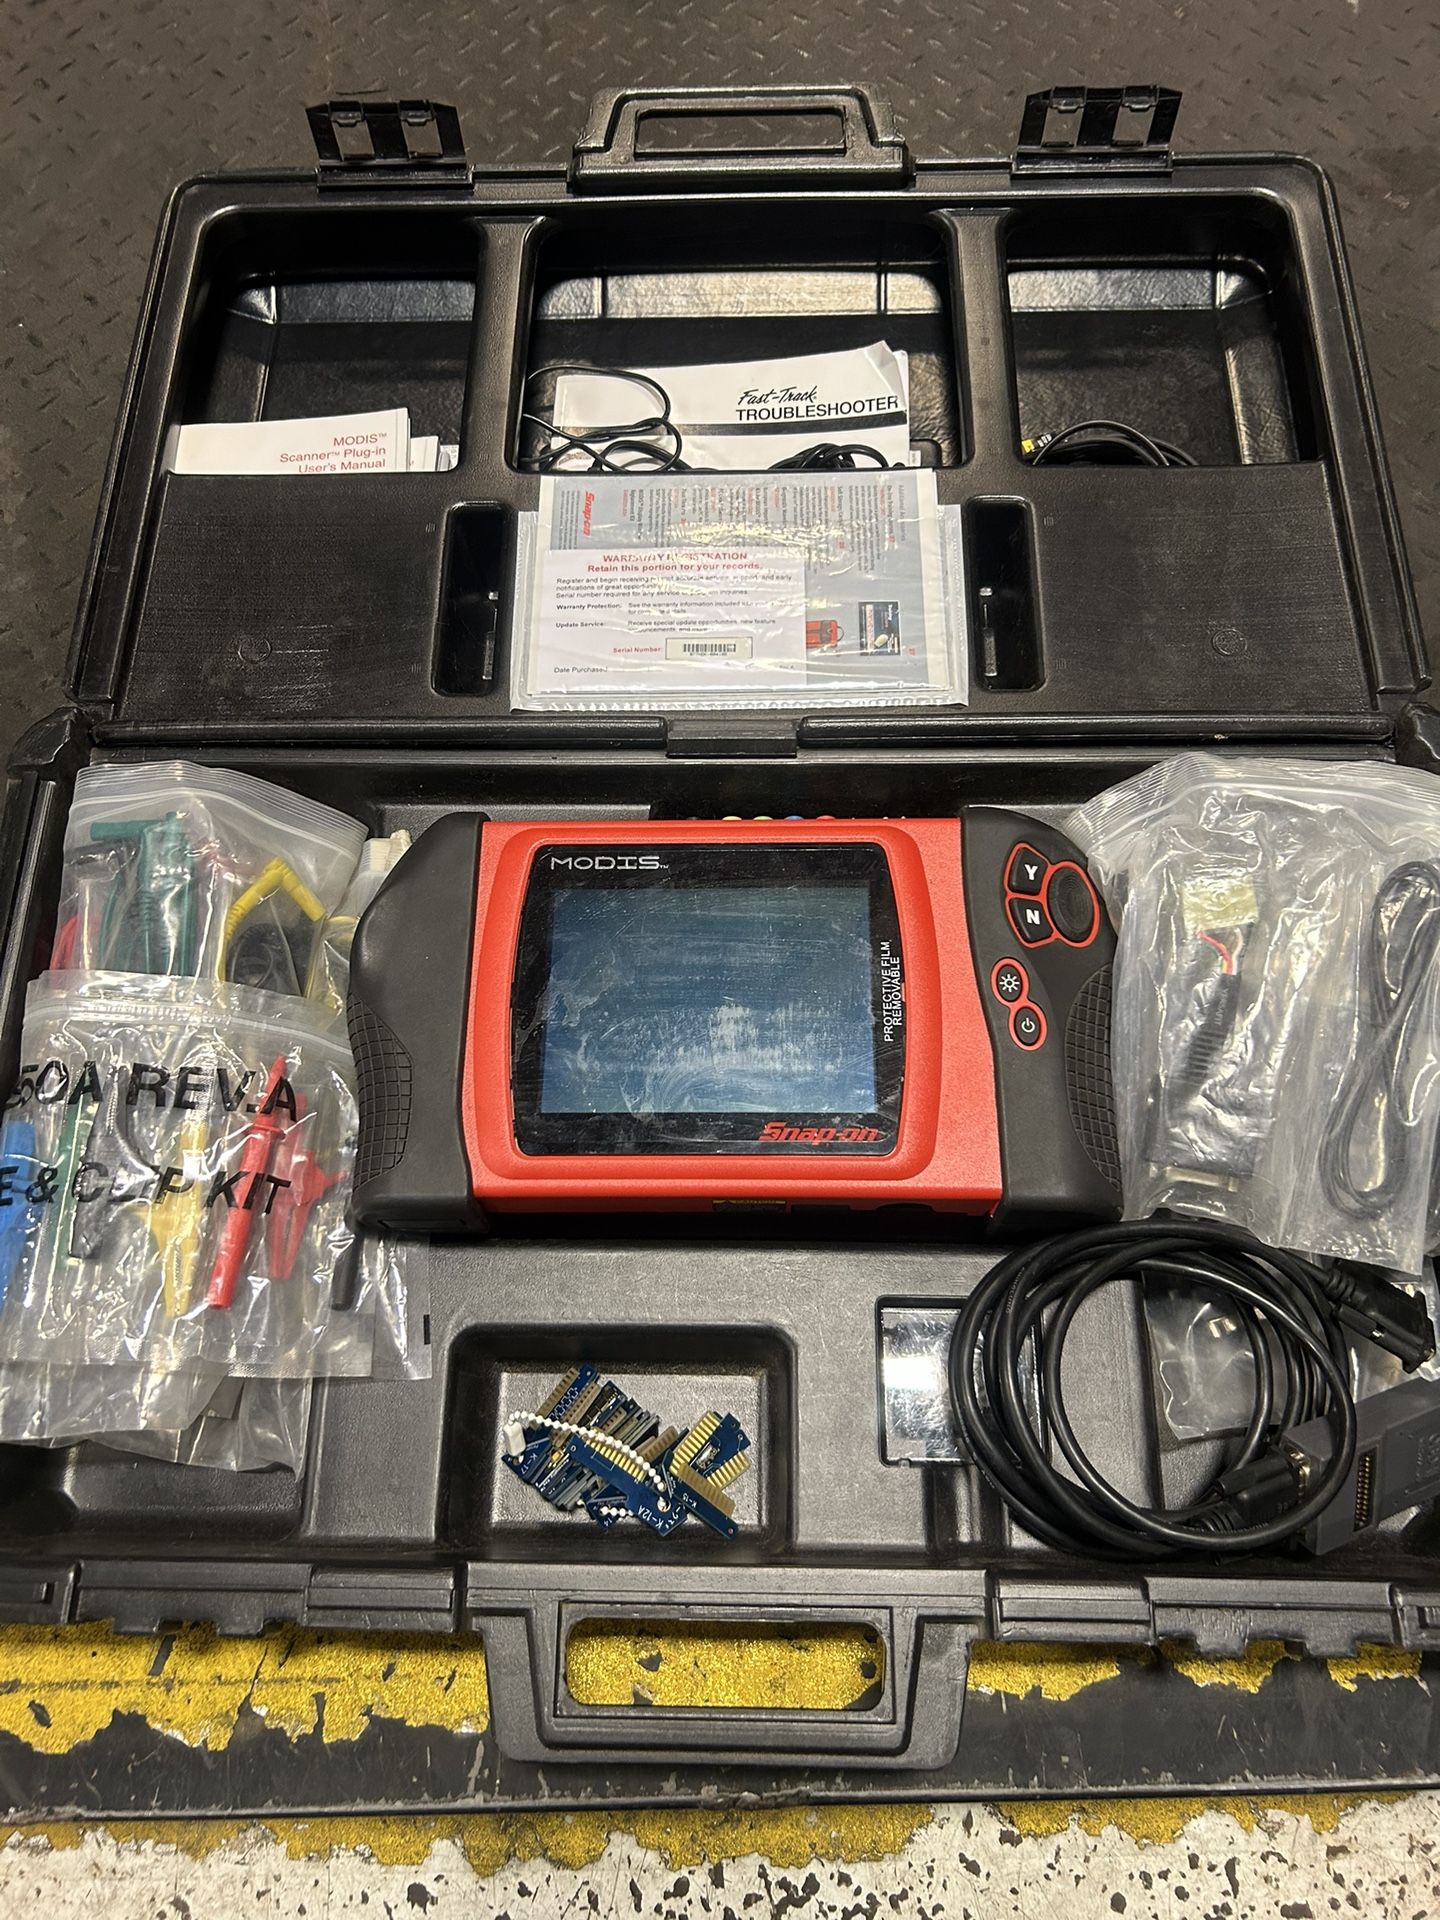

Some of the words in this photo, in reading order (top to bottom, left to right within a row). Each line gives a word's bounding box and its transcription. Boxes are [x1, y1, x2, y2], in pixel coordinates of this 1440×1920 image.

[736, 395, 899, 422] TROUBLESHOOTER
[343, 447, 386, 459] Plug-in
[298, 462, 337, 474] User's
[340, 459, 386, 471] Manual
[582, 491, 595, 537] Snap-on
[588, 564, 618, 572] Retain
[621, 563, 639, 571] this
[642, 563, 677, 573] portion
[680, 562, 694, 571] for
[696, 562, 720, 572] your
[556, 577, 585, 585] Register
[600, 576, 619, 585] begin
[605, 584, 622, 592] great
[577, 591, 601, 599] number
[603, 591, 630, 599] required
[557, 603, 586, 611] Warranty
[587, 602, 622, 610] Protection:
[680, 601, 713, 609] information
[653, 620, 675, 628] special
[554, 666, 570, 674] Date
[1024, 863, 1039, 881] Y
[1026, 908, 1040, 925] N
[880, 941, 891, 967] FILM
[890, 956, 902, 1026] REMOVABLE
[881, 969, 894, 1042] PROTECTIVE
[758, 1120, 880, 1147] Snap-on
[25, 1166, 58, 1204] &
[204, 1170, 292, 1214] KIT
[520, 1452, 538, 1474] K-17
[637, 1504, 664, 1529] K-12A
